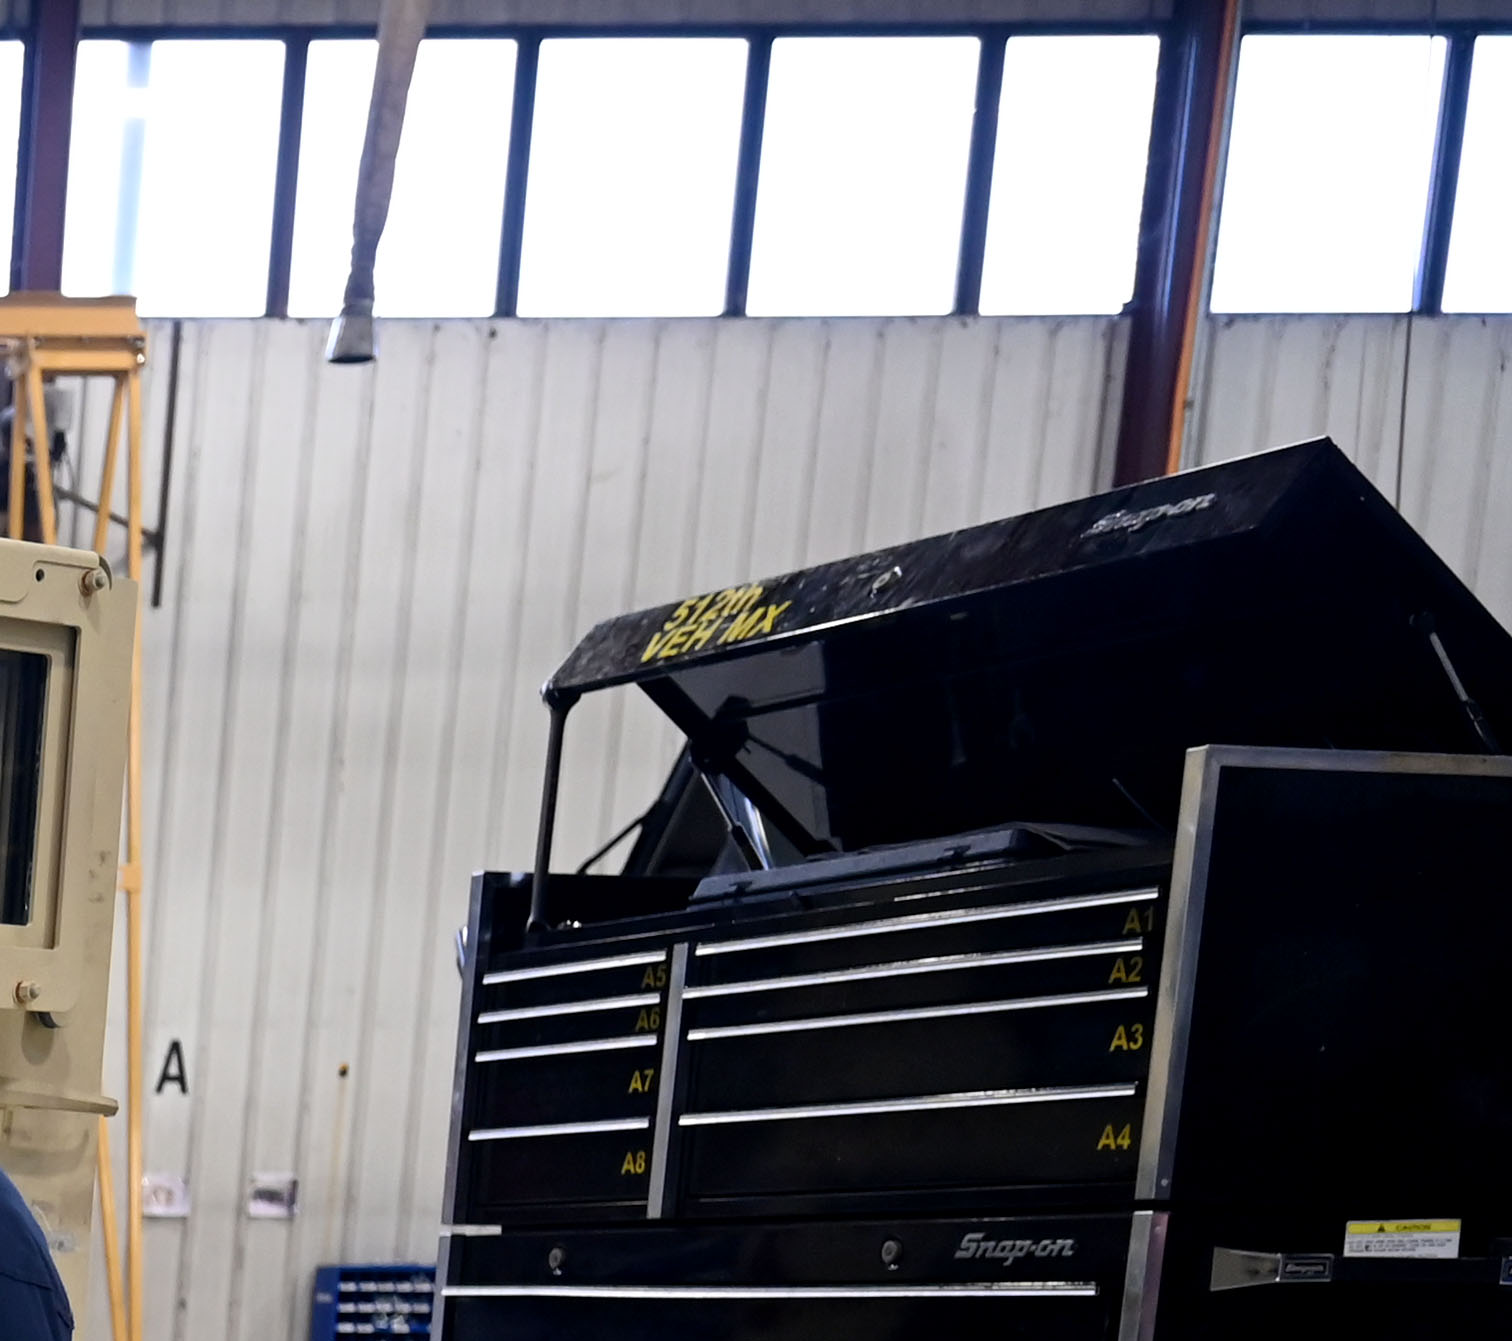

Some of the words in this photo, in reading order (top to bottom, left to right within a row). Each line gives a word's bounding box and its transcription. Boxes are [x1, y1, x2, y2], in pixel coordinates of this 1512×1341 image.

[640, 617, 726, 662] VEH
[717, 600, 792, 645] MX
[1124, 907, 1154, 934] A1
[1110, 957, 1143, 983] A2
[636, 1005, 661, 1030] A6
[1110, 1023, 1144, 1051] A3
[155, 1039, 188, 1095] A
[629, 1069, 654, 1093] A7
[1097, 1123, 1132, 1150] A4
[621, 1150, 646, 1175] A8
